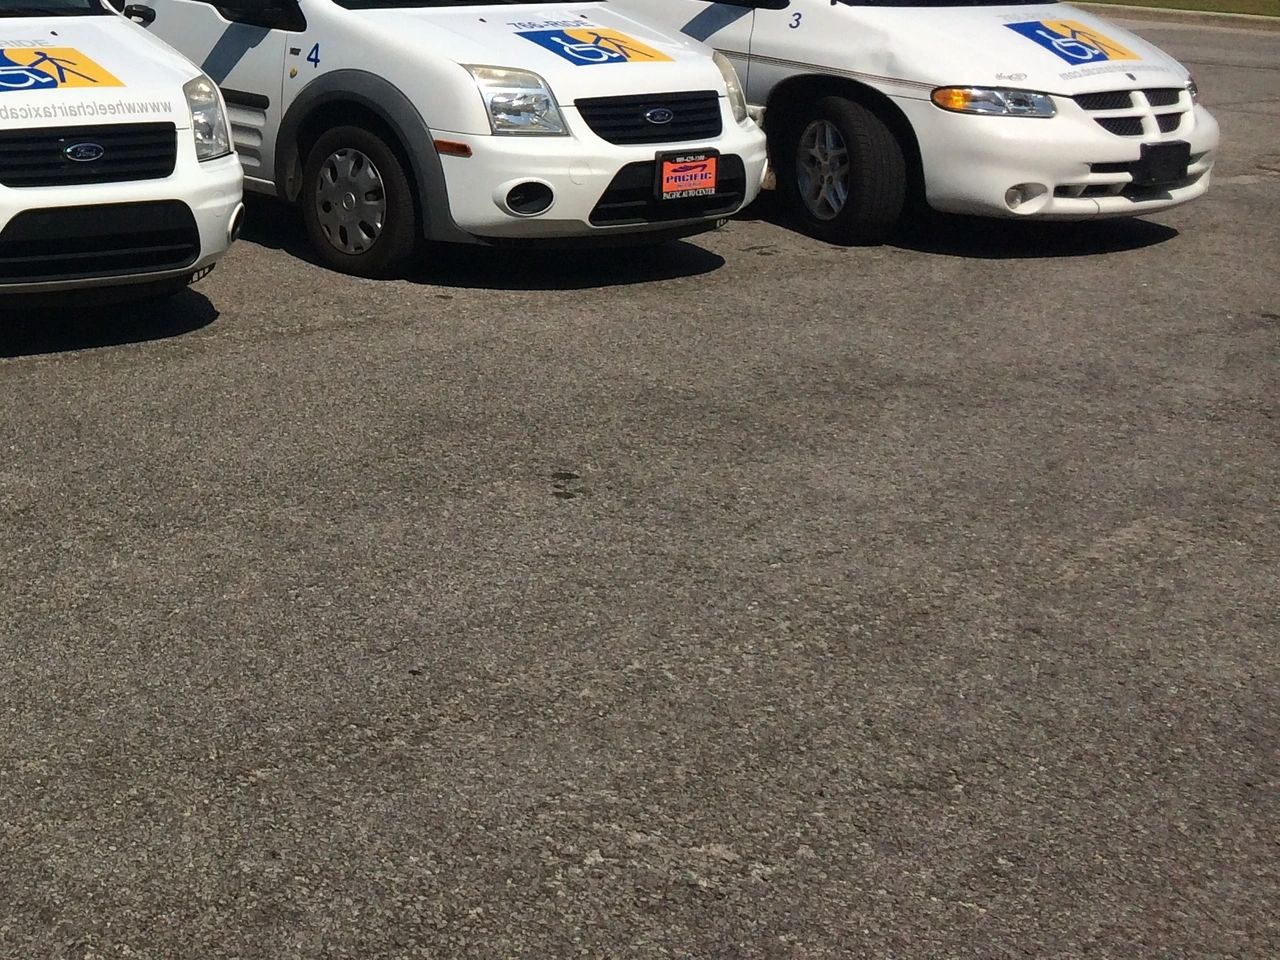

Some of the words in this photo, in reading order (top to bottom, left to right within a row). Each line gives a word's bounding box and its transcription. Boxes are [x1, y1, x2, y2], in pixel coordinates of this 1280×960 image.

[789, 12, 802, 29] 3
[306, 42, 321, 69] 4
[666, 172, 712, 183] PACIFIC
